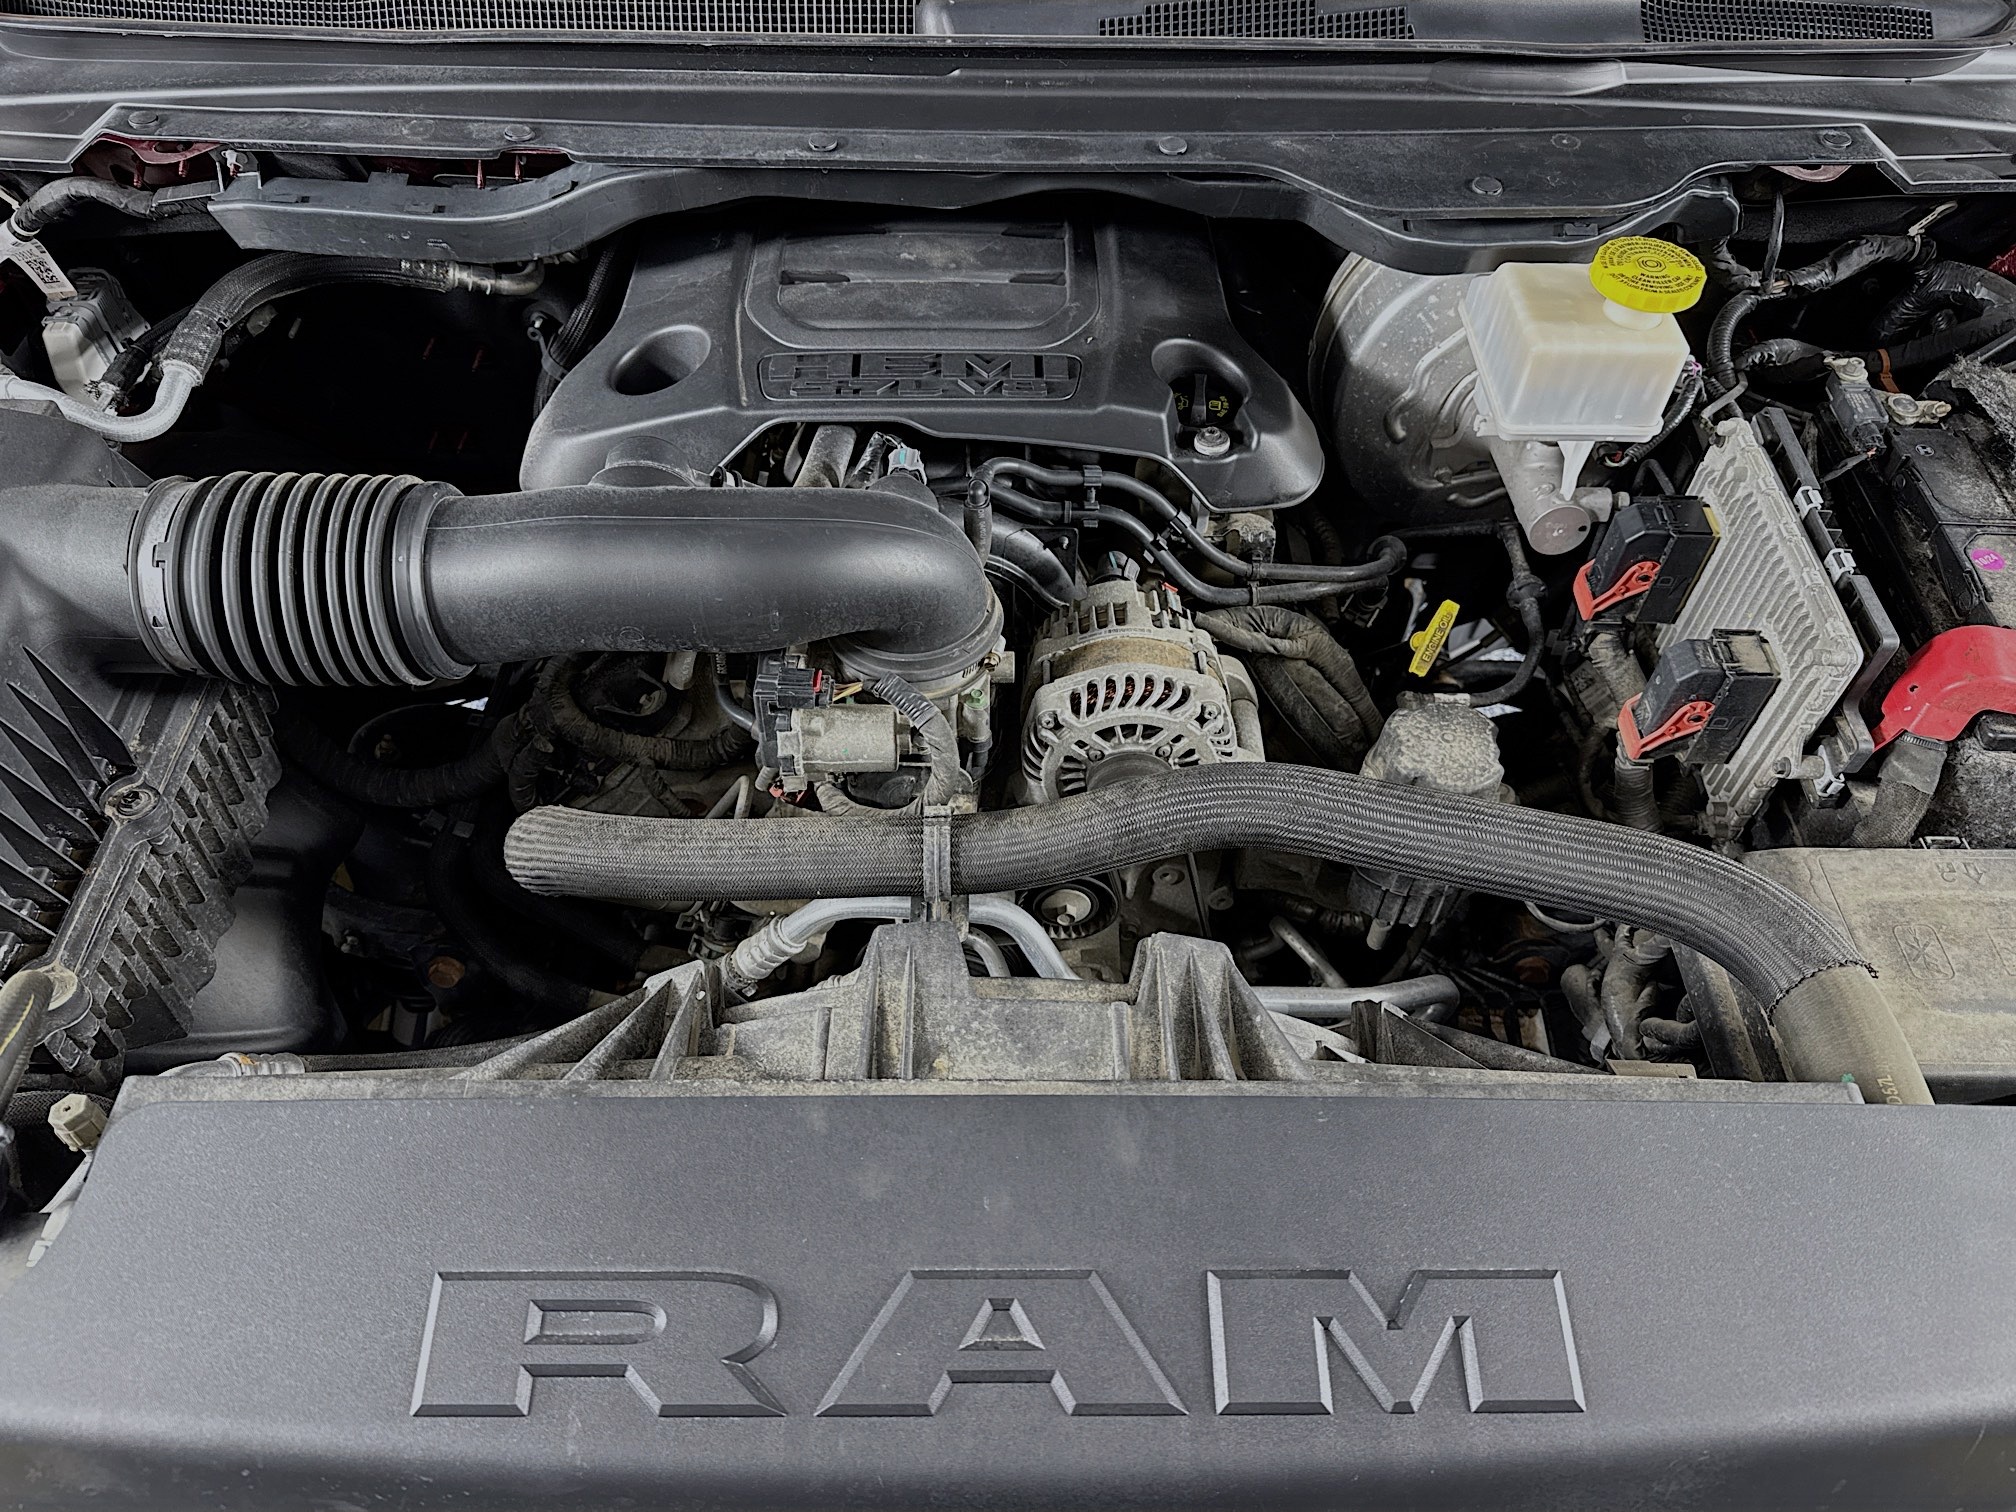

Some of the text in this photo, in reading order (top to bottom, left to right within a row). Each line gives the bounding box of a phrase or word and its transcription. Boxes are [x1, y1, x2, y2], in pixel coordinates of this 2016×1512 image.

[1630, 274, 1650, 283] CLEAN
[768, 353, 1072, 382] HEMI
[1974, 553, 1999, 566] 10/24
[1421, 611, 1454, 663] ENGINE OIL
[408, 1269, 1590, 1417] RAM
